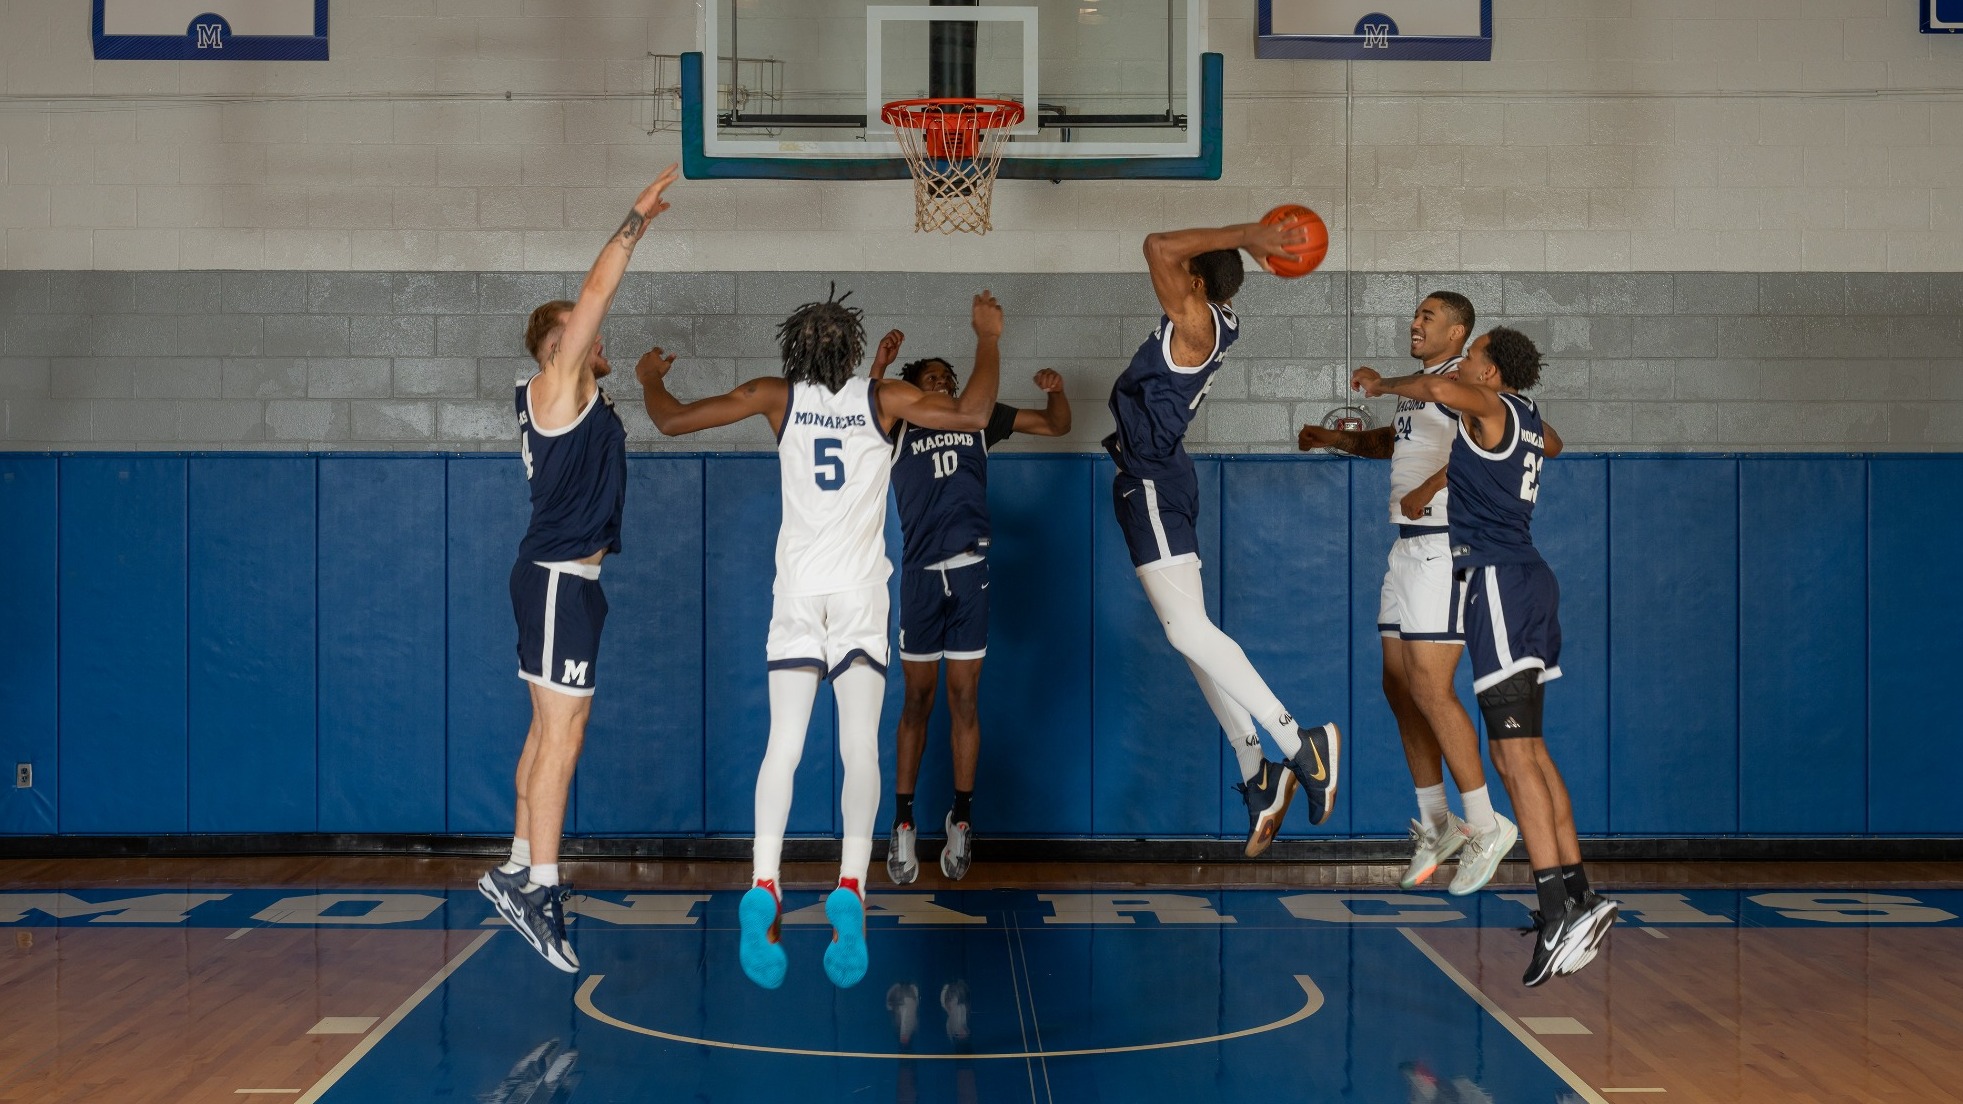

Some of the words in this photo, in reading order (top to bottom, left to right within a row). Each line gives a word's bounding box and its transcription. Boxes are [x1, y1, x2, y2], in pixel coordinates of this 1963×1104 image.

[197, 24, 223, 49] M
[1364, 24, 1389, 49] M
[1394, 416, 1412, 442] 24
[911, 432, 974, 455] MACOMB
[814, 438, 846, 492] 5
[932, 450, 958, 479] 10
[561, 658, 589, 686] M
